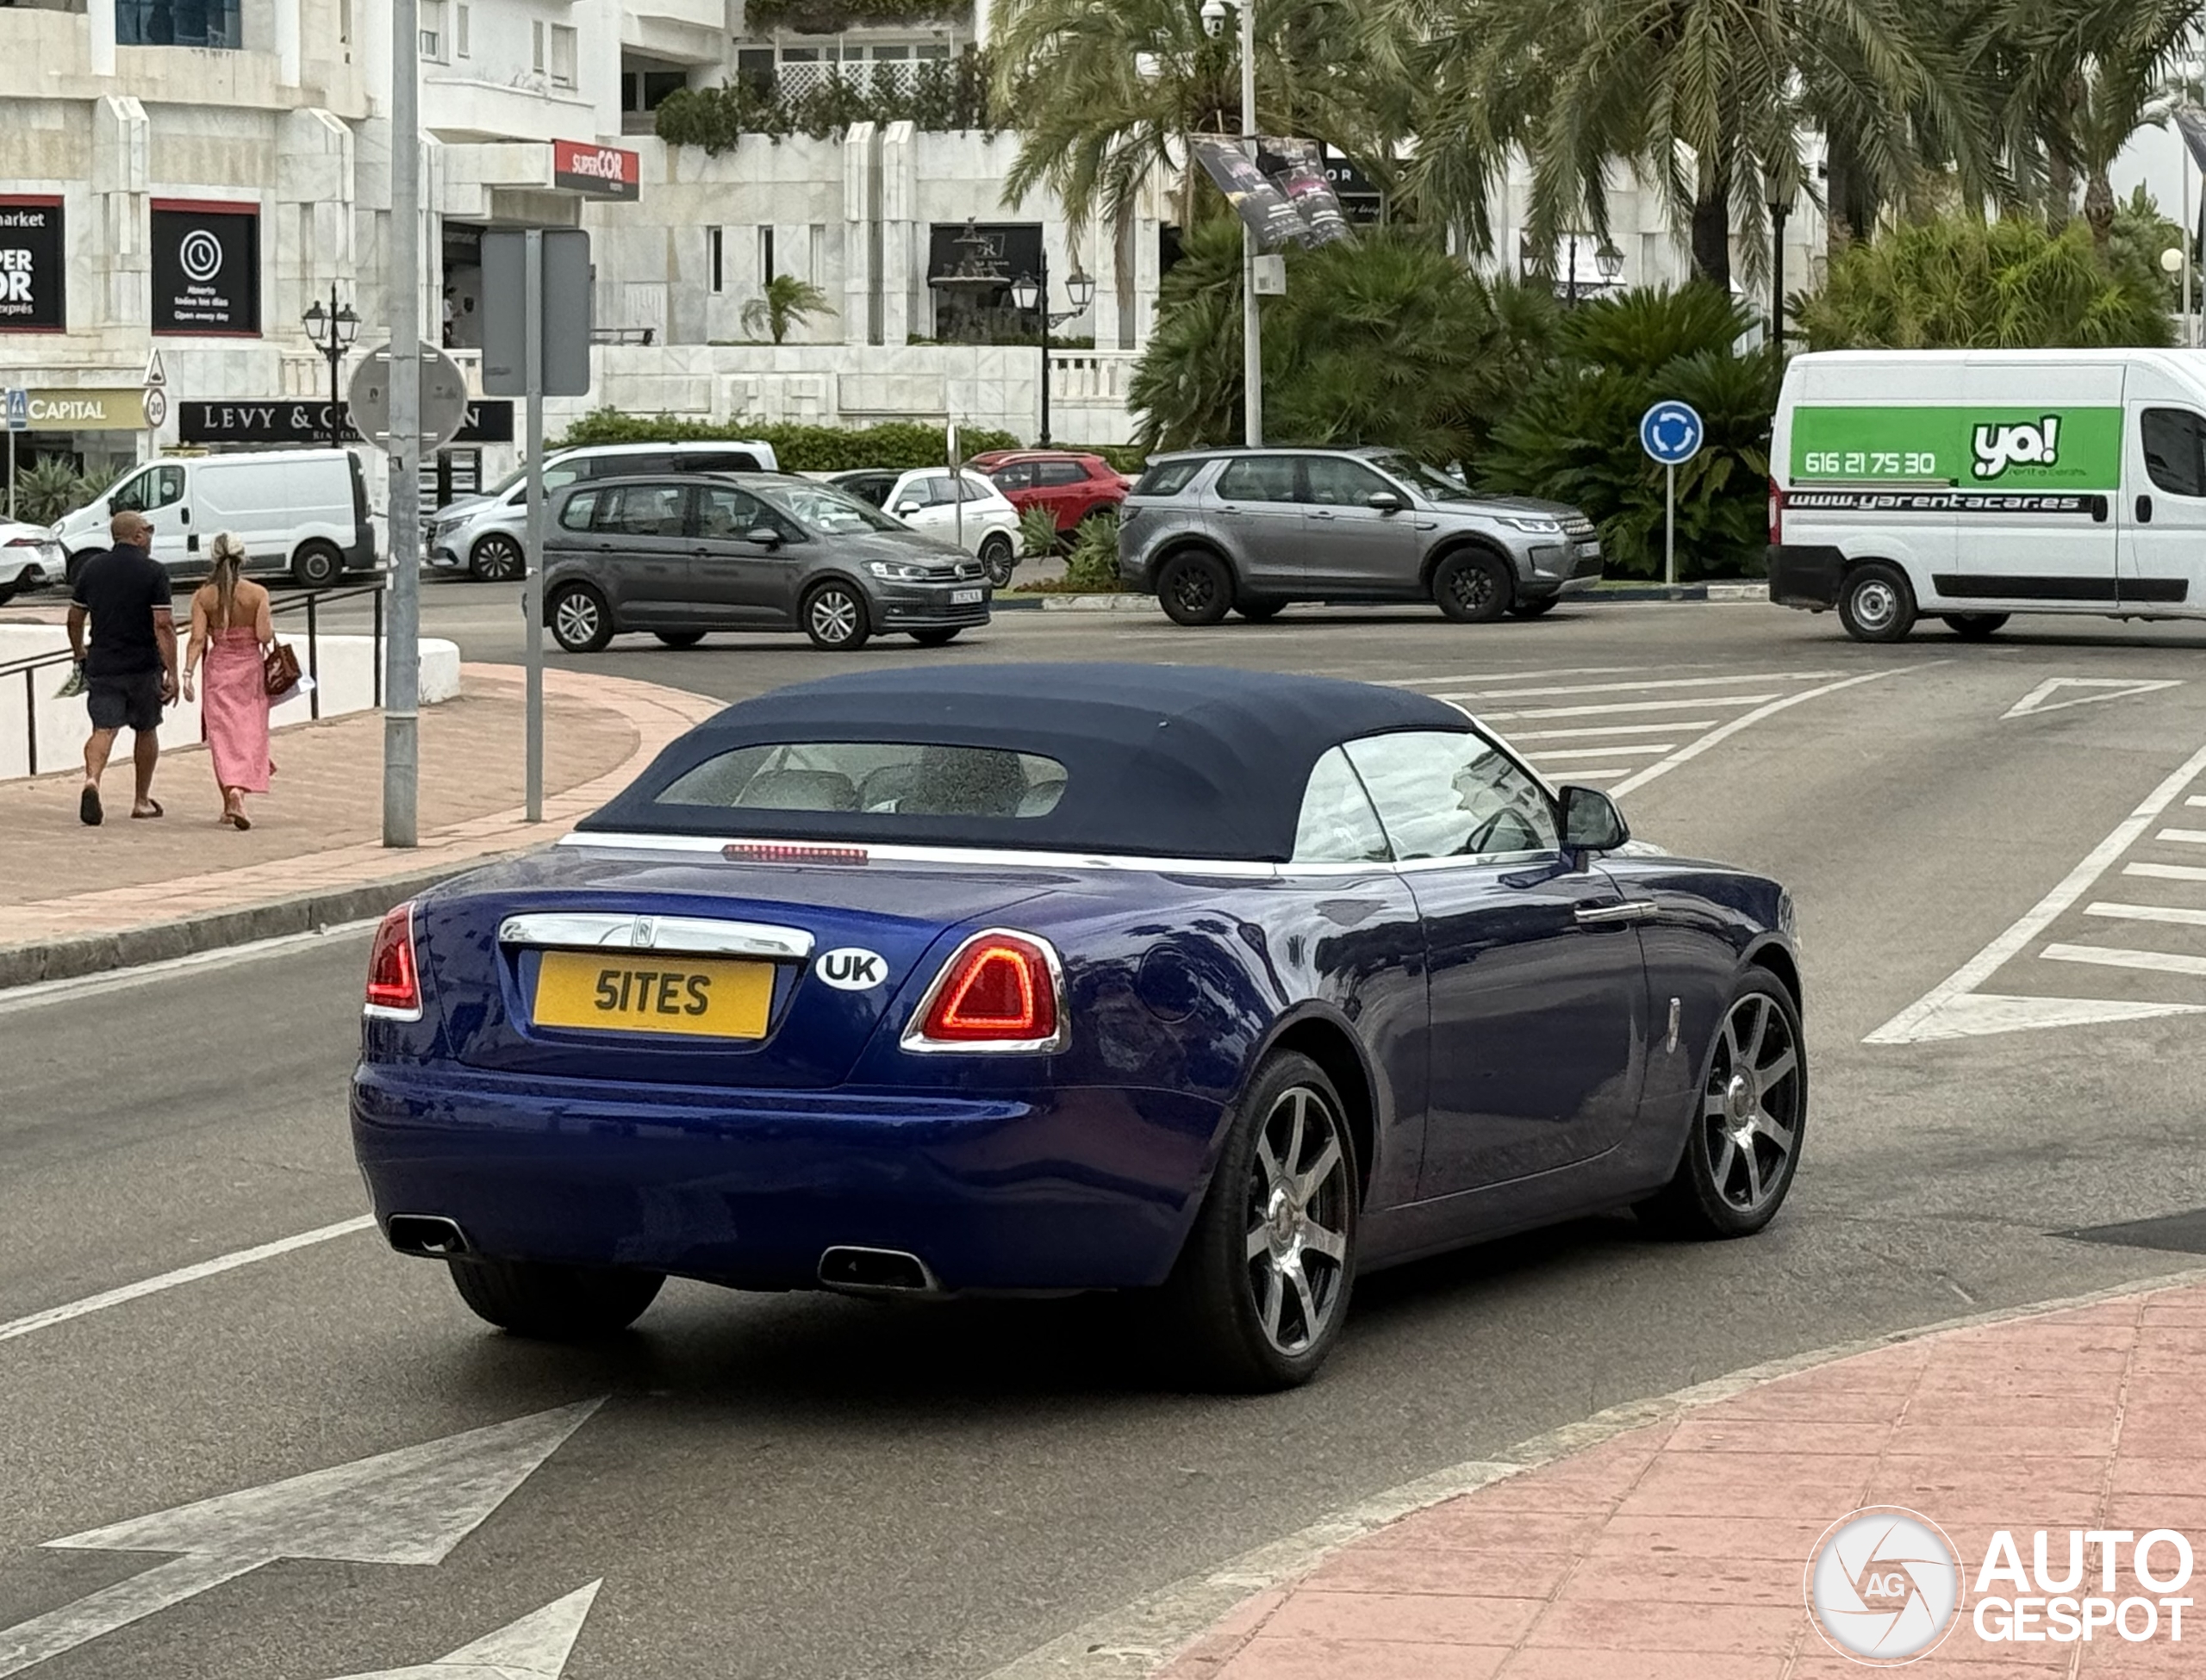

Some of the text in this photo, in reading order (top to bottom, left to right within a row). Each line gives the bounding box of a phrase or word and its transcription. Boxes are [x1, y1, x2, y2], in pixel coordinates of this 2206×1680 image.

[0, 210, 46, 227] arket
[0, 249, 34, 271] ER
[28, 399, 107, 420] CAPITAL
[203, 405, 276, 429] LEVY
[290, 405, 313, 429] &
[1805, 451, 1936, 474] 616 21 75 30
[1788, 493, 2082, 511] www.yarentacar.es
[824, 955, 878, 983] UK
